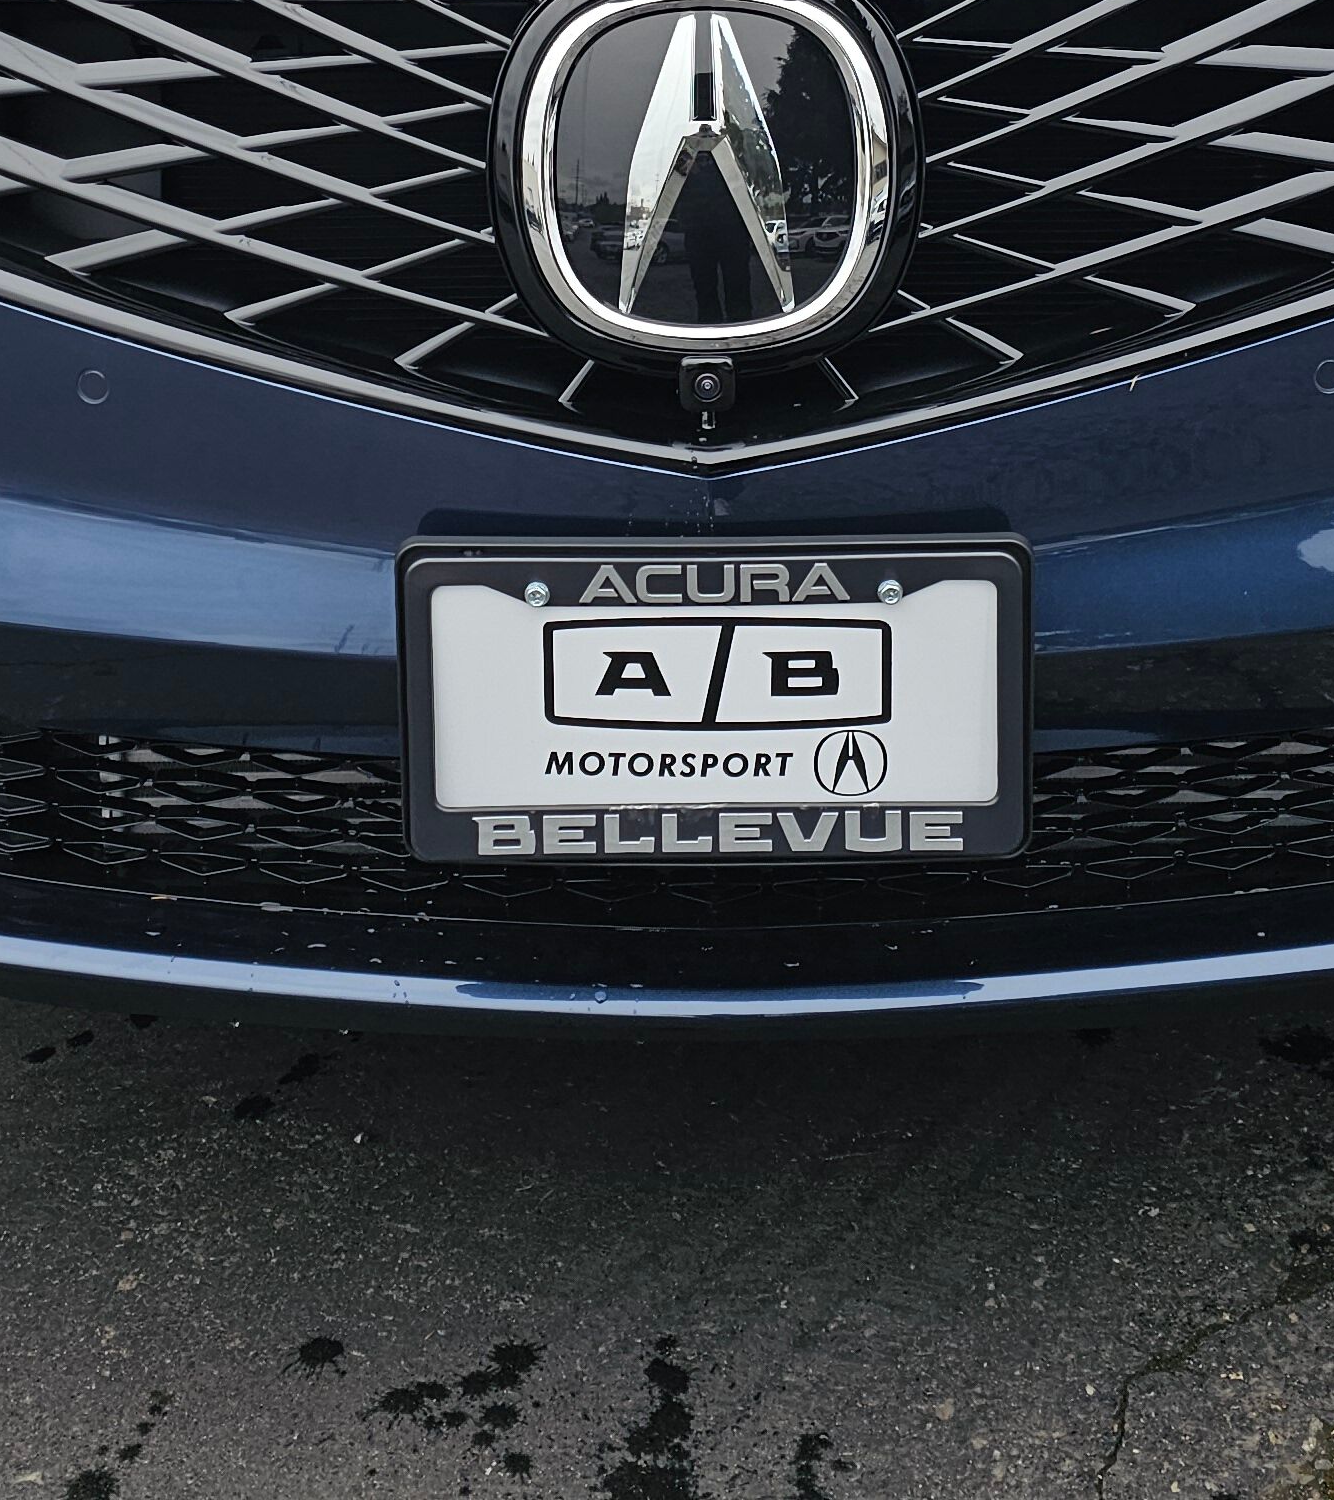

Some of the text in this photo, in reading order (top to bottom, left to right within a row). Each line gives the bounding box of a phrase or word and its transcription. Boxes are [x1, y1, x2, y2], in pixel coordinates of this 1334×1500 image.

[578, 562, 851, 604] ACURA
[544, 750, 794, 778] MOTORSPORT
[471, 810, 964, 856] BELLEVUE
